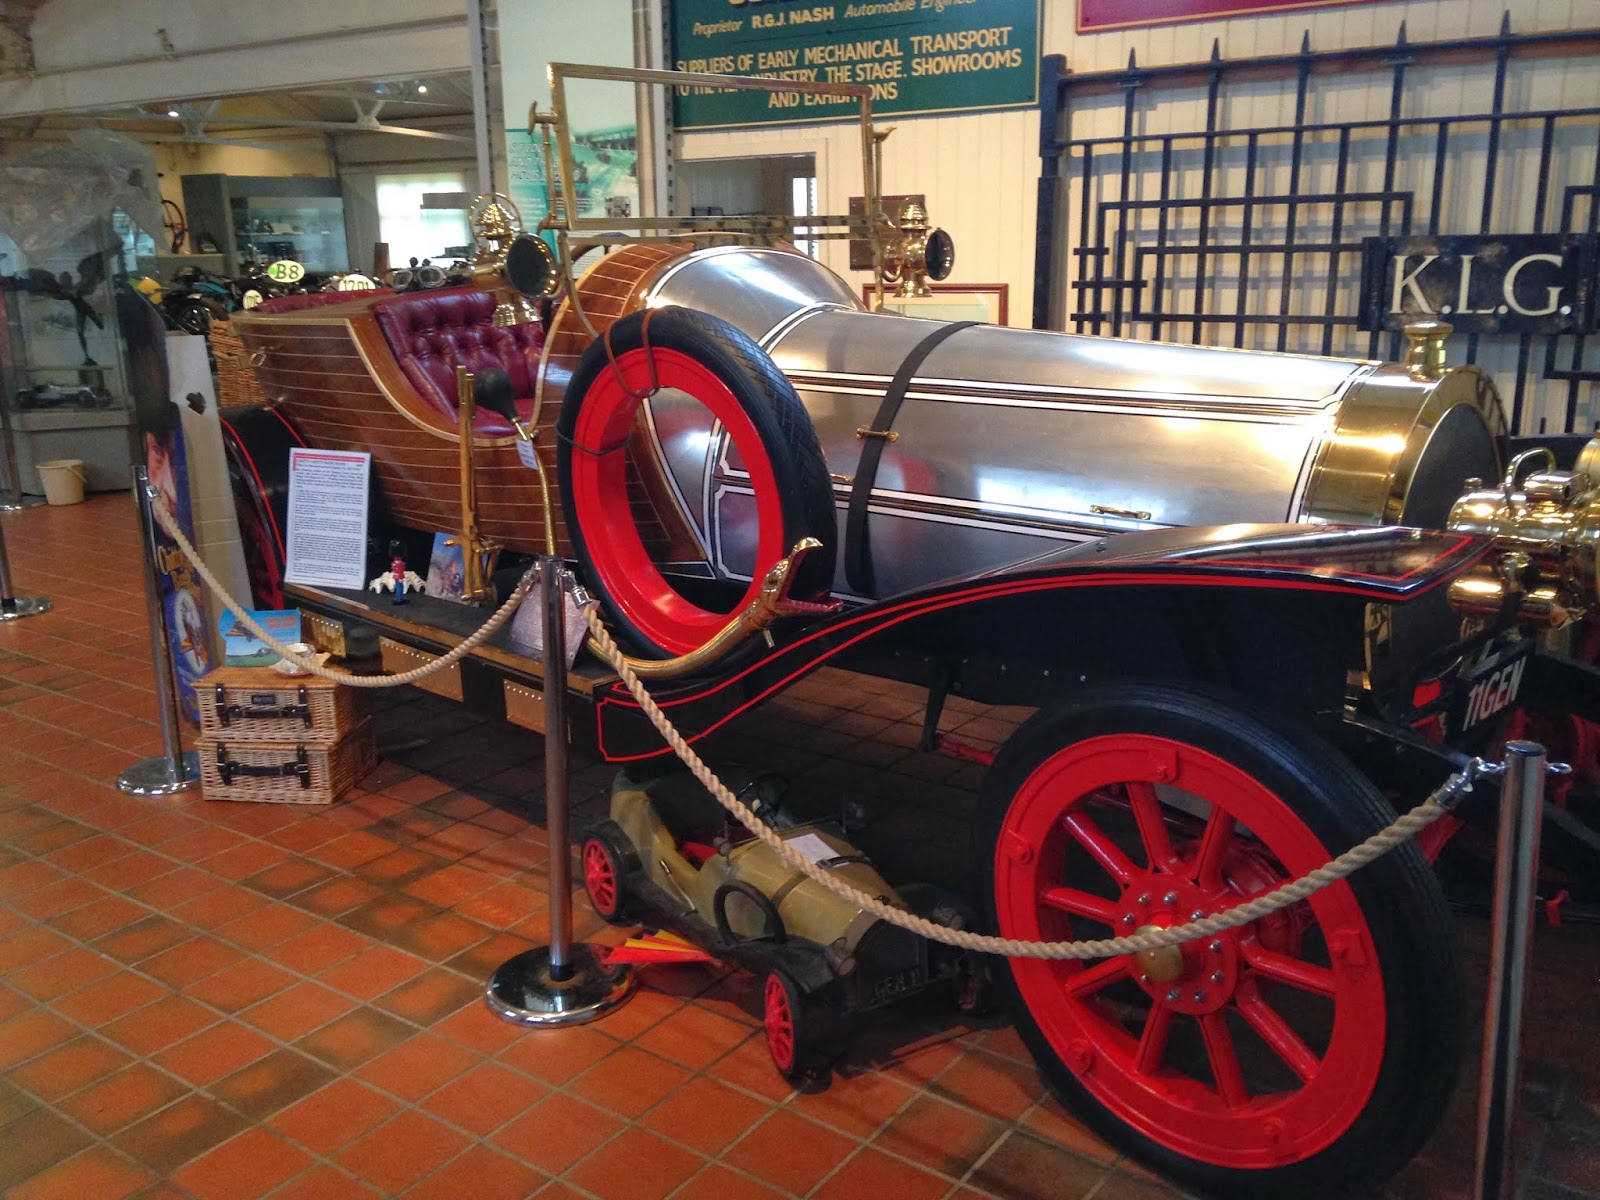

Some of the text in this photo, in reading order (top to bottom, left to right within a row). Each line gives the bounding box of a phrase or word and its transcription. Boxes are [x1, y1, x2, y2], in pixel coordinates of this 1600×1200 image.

[692, 19, 743, 39] Proprietor
[789, 6, 835, 25] NASH
[844, 0, 917, 18] Automobile
[676, 26, 1013, 74] SUPPLIERS OF EARLY MECHANICAL TRANSPORT
[825, 64, 854, 83] THE
[911, 48, 1023, 77] SHOWROOMS
[768, 91, 800, 109] AND
[275, 263, 299, 280] B8
[1389, 252, 1572, 317] K.L.G.
